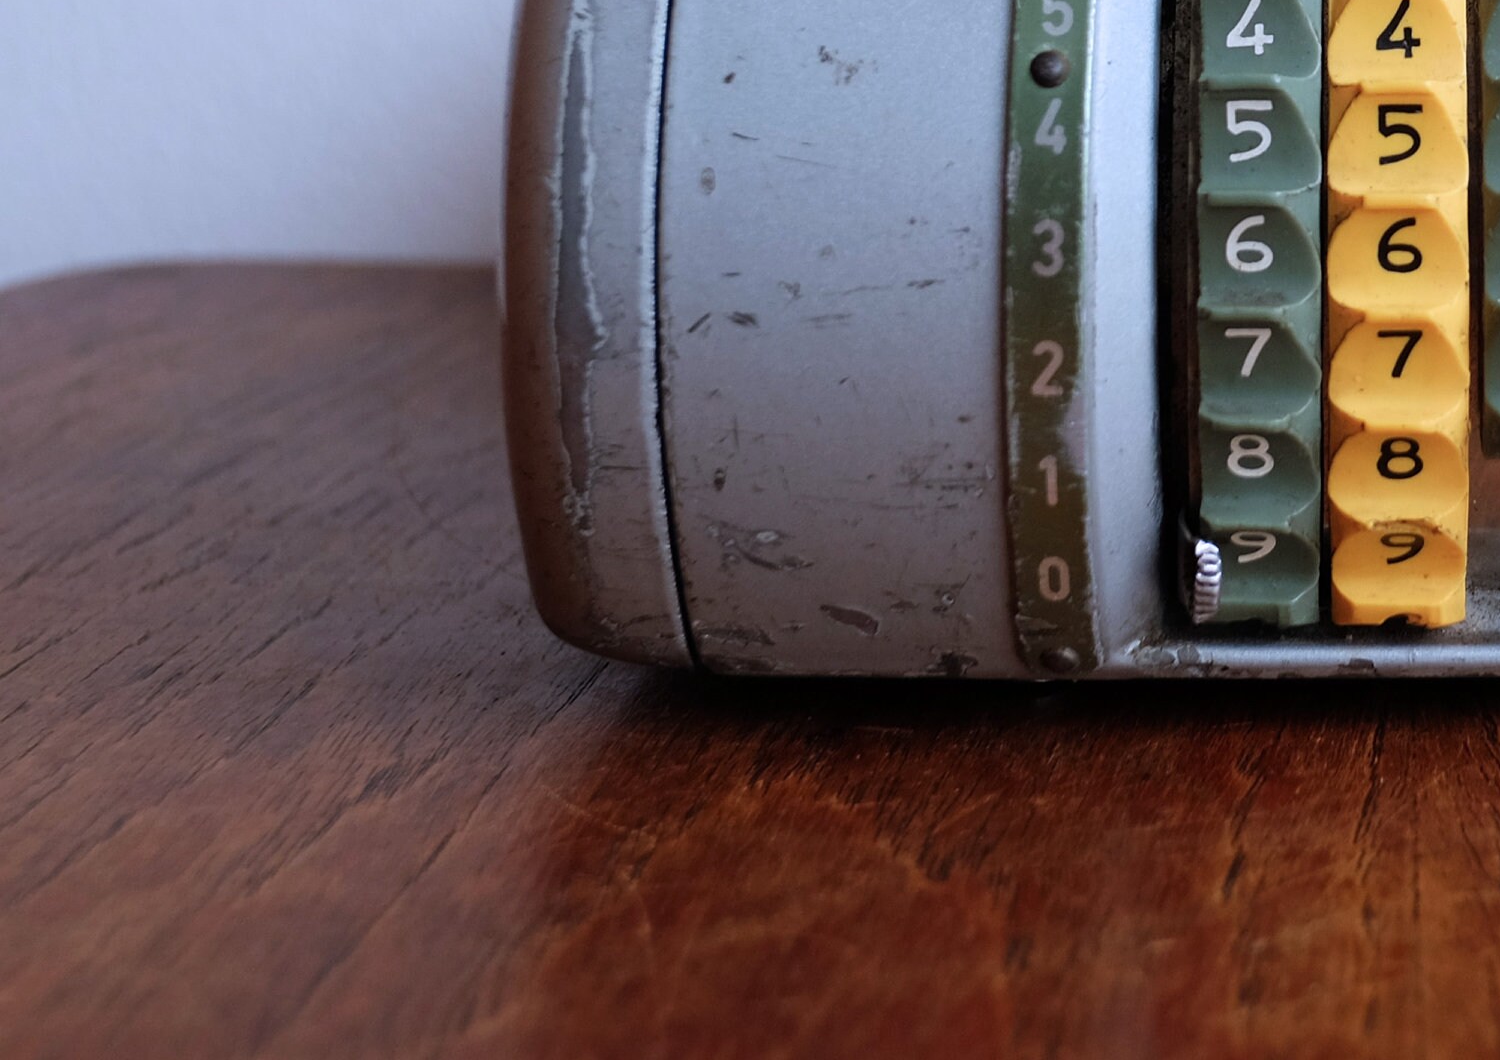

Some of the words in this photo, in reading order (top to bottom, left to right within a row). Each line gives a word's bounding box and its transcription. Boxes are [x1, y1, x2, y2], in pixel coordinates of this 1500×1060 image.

[1035, 98, 1066, 154] 4
[1225, 100, 1274, 162] 5
[1377, 104, 1423, 165] 5
[1032, 220, 1064, 277] 3
[1225, 215, 1274, 272] 6
[1377, 217, 1423, 273] 6
[1031, 340, 1064, 396] 2
[1225, 328, 1272, 377] 7
[1377, 329, 1423, 378] 7
[1227, 434, 1274, 477] 8
[1377, 437, 1424, 479] 8
[1038, 456, 1057, 506] 1
[1230, 531, 1276, 563] 9
[1379, 533, 1425, 564] 9
[1038, 557, 1071, 601] 0
